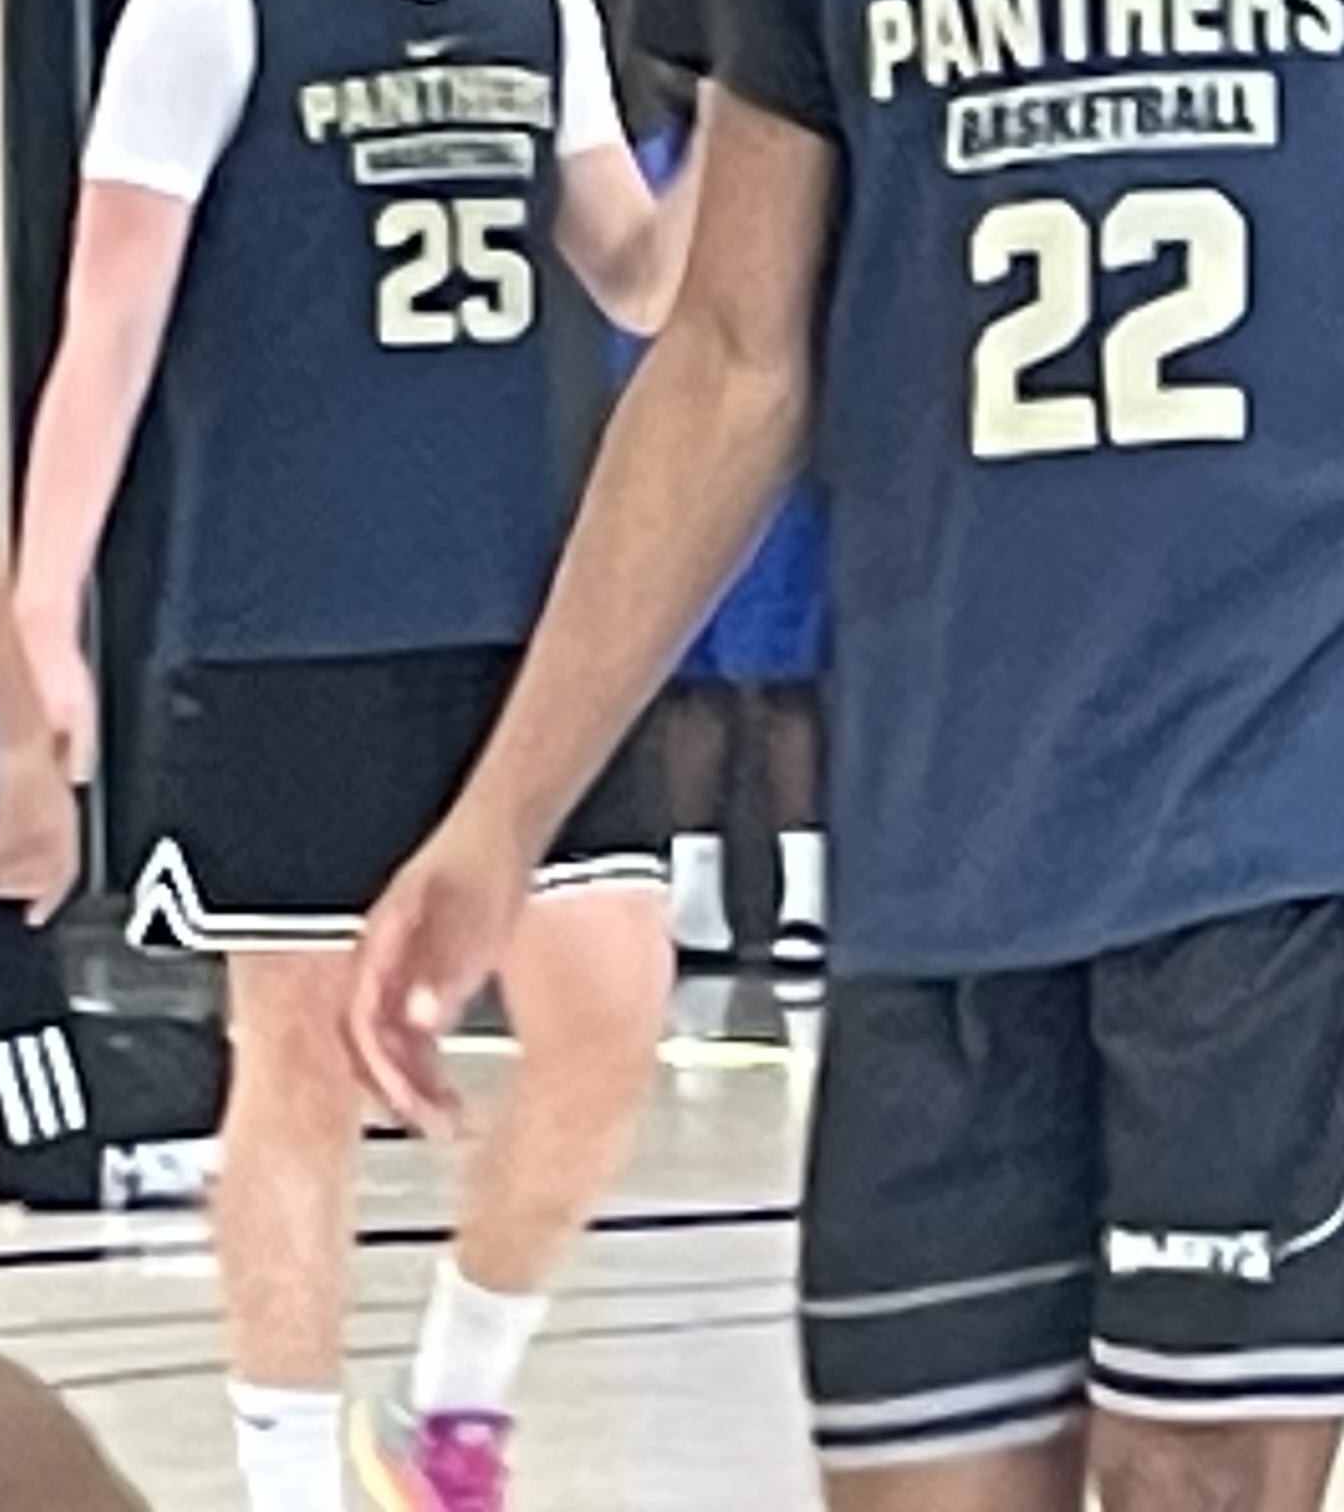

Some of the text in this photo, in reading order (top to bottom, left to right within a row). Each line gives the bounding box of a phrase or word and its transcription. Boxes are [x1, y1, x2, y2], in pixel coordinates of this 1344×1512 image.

[955, 80, 1259, 161] BASKETBALL
[375, 197, 534, 345] 25
[970, 186, 1248, 458] 22
